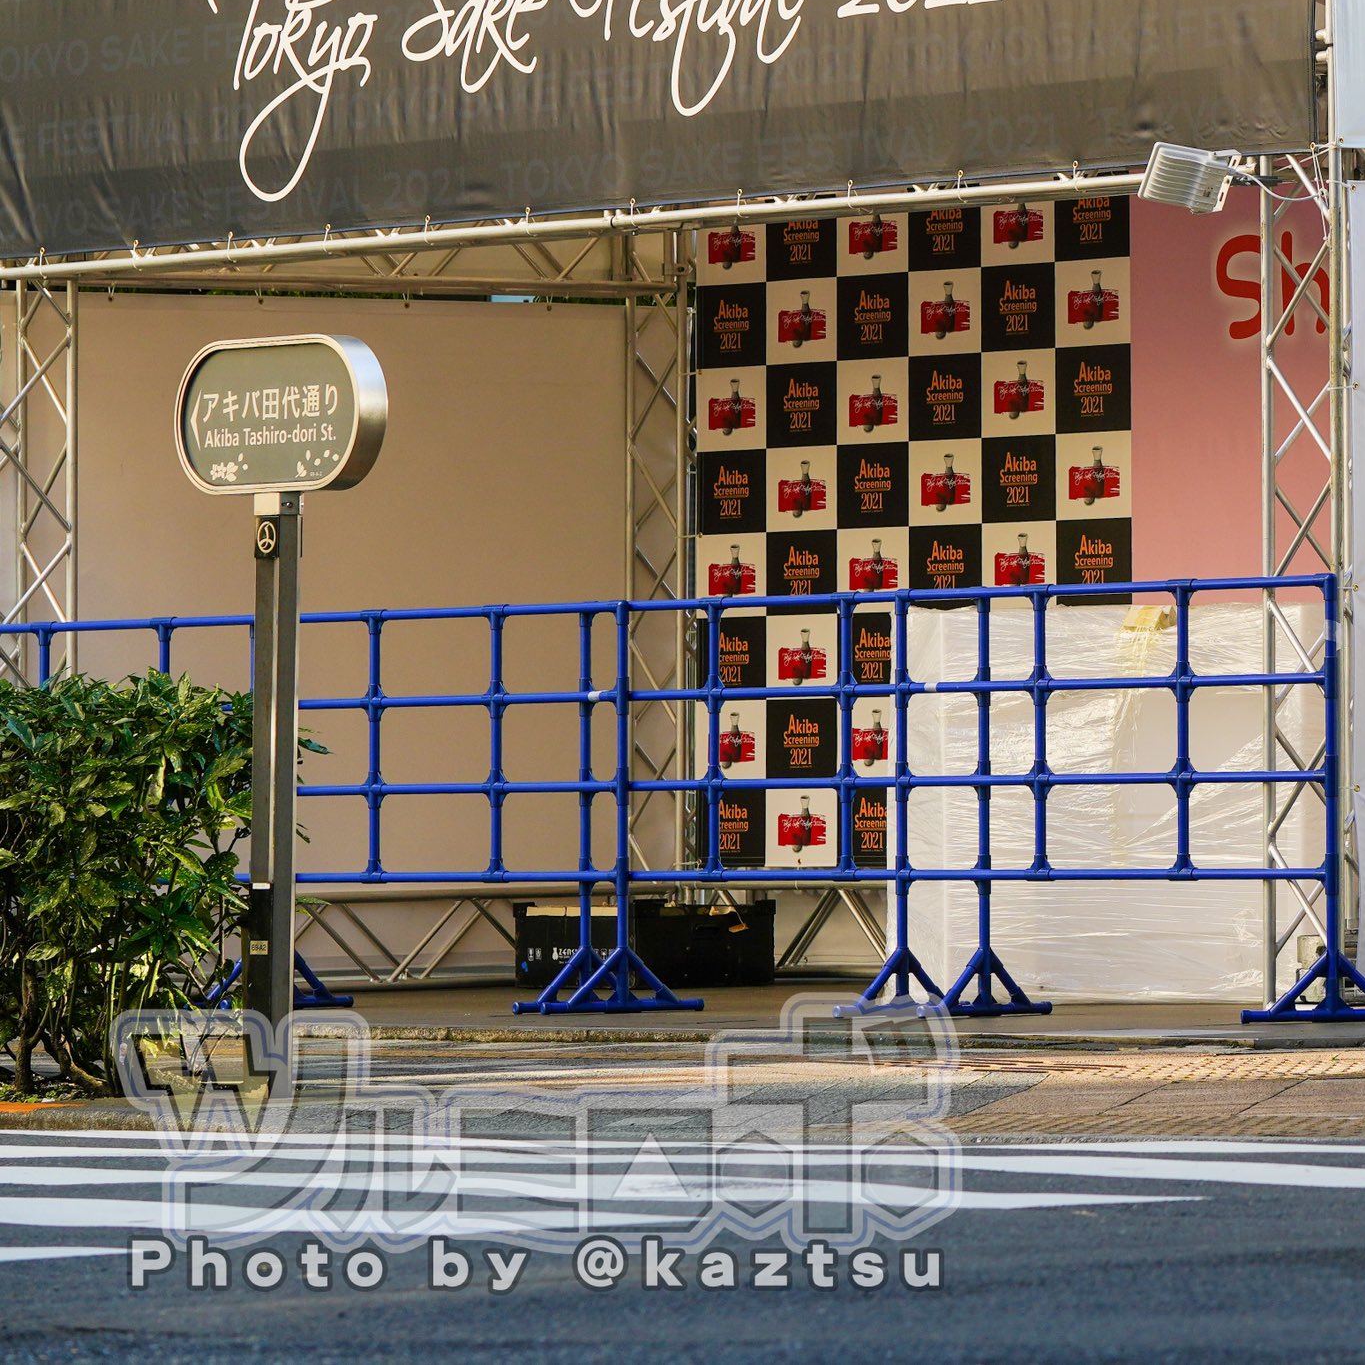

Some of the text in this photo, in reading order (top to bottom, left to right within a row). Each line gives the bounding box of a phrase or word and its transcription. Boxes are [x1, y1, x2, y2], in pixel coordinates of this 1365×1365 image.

[1072, 206, 1112, 221] Screening
[926, 217, 963, 232] Screening
[1080, 223, 1103, 241] 2021
[783, 228, 820, 242] Screening
[932, 234, 955, 252] 2021
[790, 245, 812, 261] 2021
[1004, 280, 1036, 300] Akiba
[859, 290, 890, 310] Akiba
[999, 299, 1037, 313] Screening
[718, 299, 748, 319] Akiba
[854, 307, 891, 322] Screening
[713, 316, 749, 331] Screening
[1006, 315, 1029, 332] 2021
[719, 333, 742, 349] 2021
[860, 324, 883, 341] 2021
[931, 370, 963, 390] Akiba
[1078, 362, 1111, 382] Akiba
[788, 378, 819, 398] Akiba
[926, 387, 964, 403] Screening
[1074, 379, 1113, 394] Screening
[202, 383, 338, 423] アキバ田代通り
[783, 395, 820, 410] Screening
[1081, 396, 1104, 414] 2021
[790, 412, 812, 429] 2021
[933, 404, 956, 422] 2021
[204, 423, 336, 448] Akiba Tashiro-dori St.
[859, 459, 890, 478] Akiba
[1004, 451, 1037, 471] Akiba
[718, 466, 748, 485] Akiba
[854, 476, 891, 491] Screening
[999, 469, 1038, 484] Screening
[713, 482, 749, 497] Screening
[1006, 486, 1030, 504] 2021
[719, 499, 742, 516] 2021
[860, 493, 883, 510] 2021
[931, 540, 963, 560] Akiba
[1079, 534, 1112, 555] Akiba
[788, 546, 819, 566] Akiba
[1074, 552, 1114, 568] Screening
[783, 563, 820, 578] Screening
[927, 558, 964, 573] Screening
[933, 575, 956, 588] 2021
[1082, 569, 1105, 584] 2021
[790, 580, 812, 595] 2021
[720, 632, 748, 651] Akiba
[859, 628, 891, 647] Akiba
[719, 652, 749, 664] creening
[854, 645, 891, 660] Screening
[720, 665, 742, 683] 2021
[861, 662, 884, 679] 2021
[788, 714, 819, 734] Akiba
[783, 731, 819, 746] Screening
[789, 748, 812, 765] 2021
[719, 799, 748, 819] Akiba
[719, 818, 748, 831] creening
[855, 814, 887, 828] Screenin
[719, 834, 741, 850] 2021
[861, 832, 883, 849] 2021
